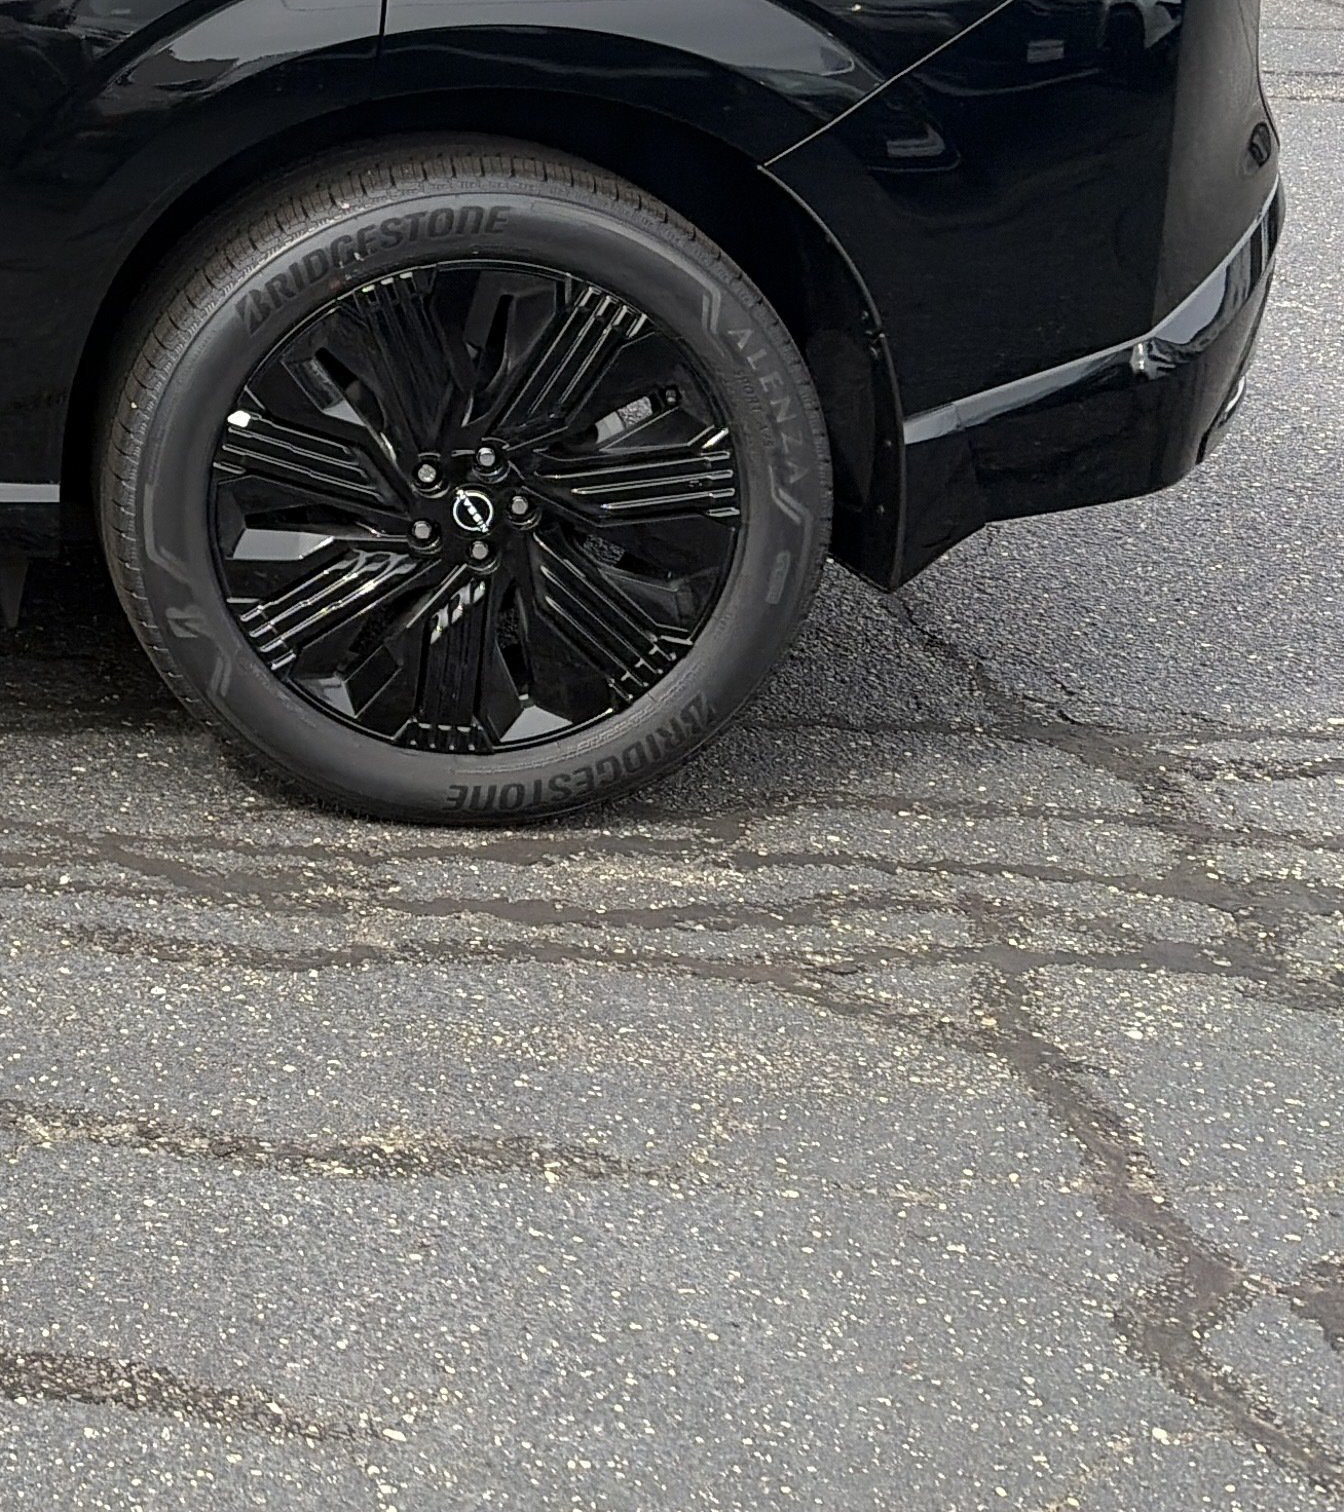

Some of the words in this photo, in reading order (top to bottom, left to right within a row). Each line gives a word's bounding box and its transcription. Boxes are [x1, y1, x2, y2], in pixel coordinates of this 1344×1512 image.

[234, 205, 513, 335] BRIDGESTONE
[727, 327, 810, 485] ALENZA
[442, 691, 716, 813] BRIDGESTONE
